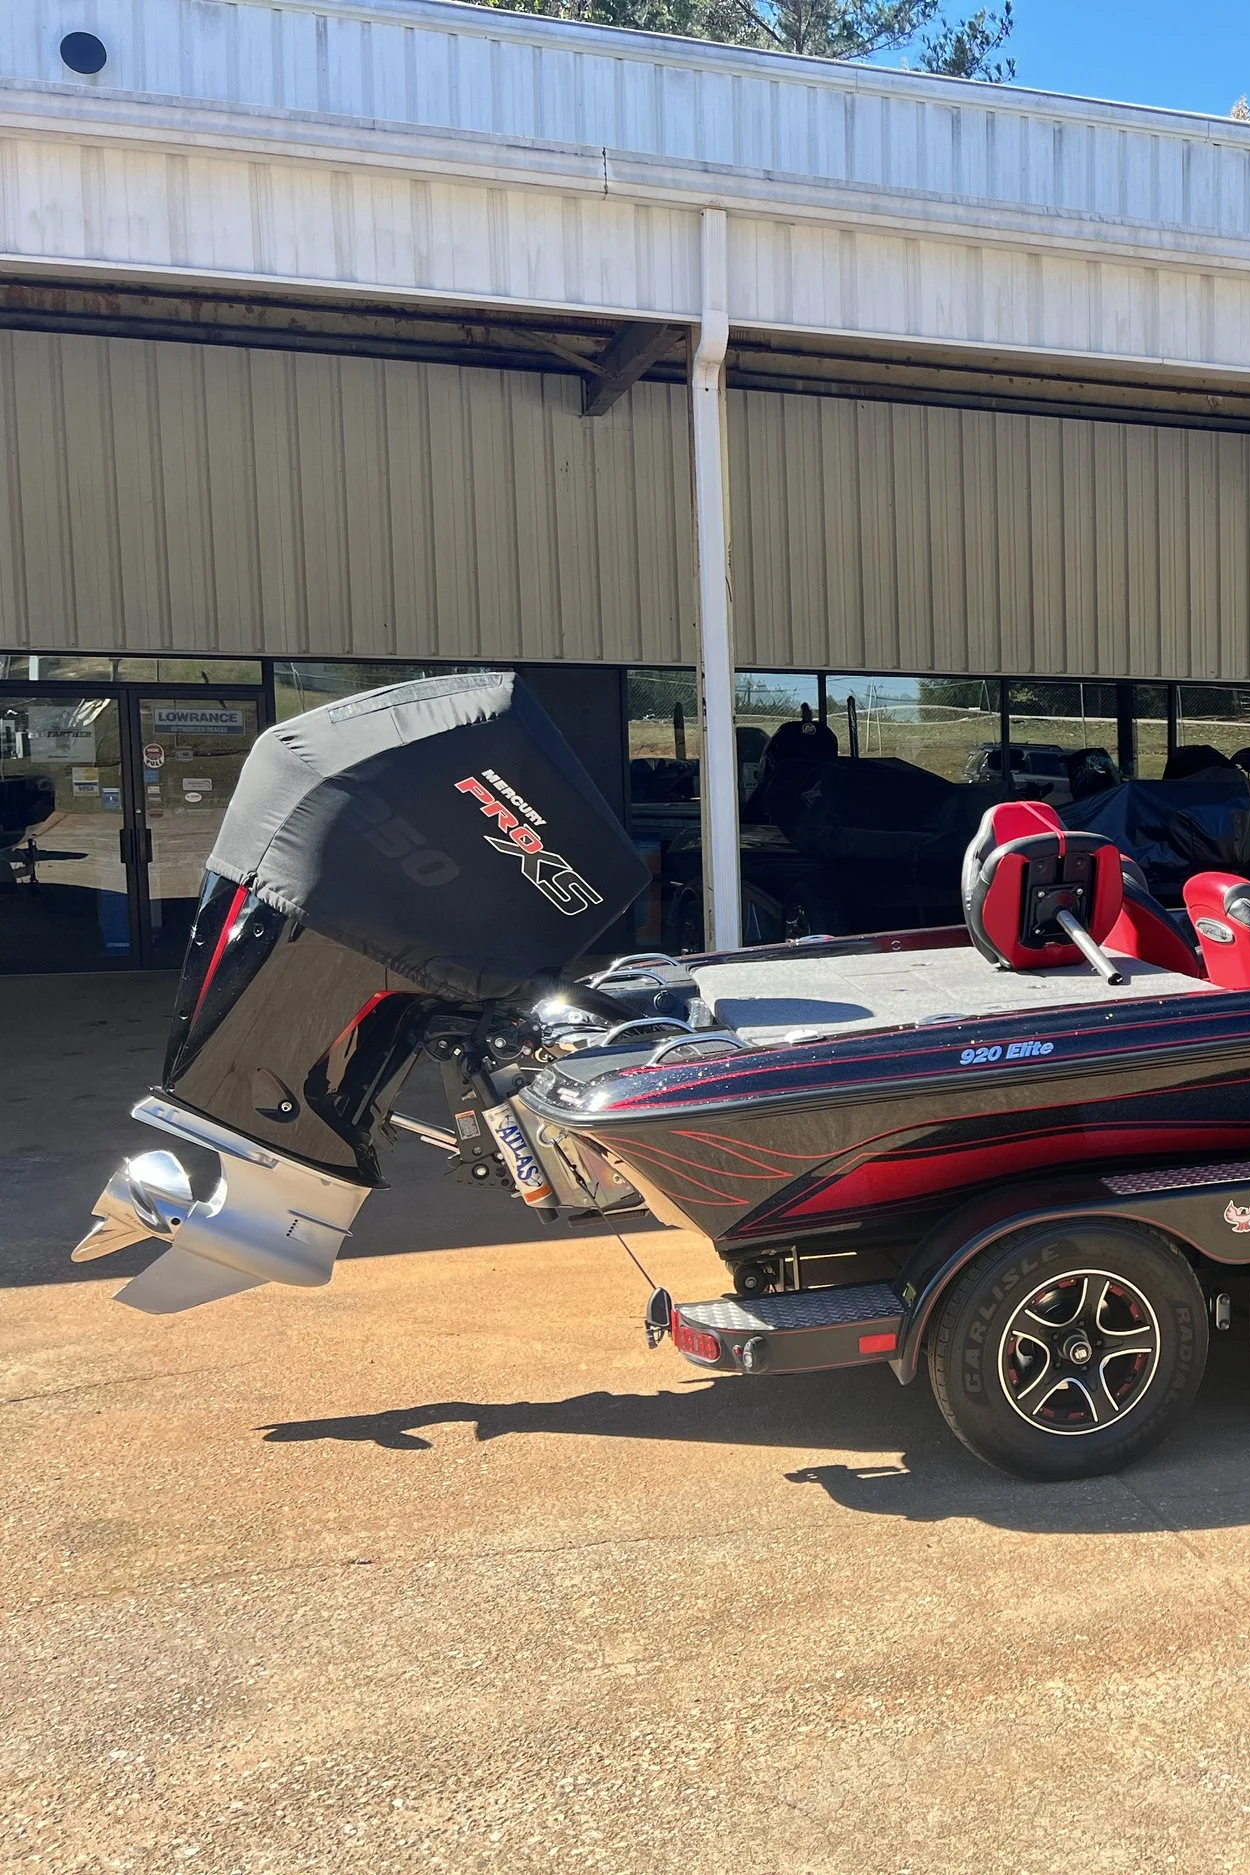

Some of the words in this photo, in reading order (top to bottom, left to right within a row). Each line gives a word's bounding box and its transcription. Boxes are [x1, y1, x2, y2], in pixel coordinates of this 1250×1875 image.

[158, 711, 238, 723] LOWRANCE
[481, 768, 547, 827] MERCURY
[959, 1045, 1003, 1065] 920
[1005, 1041, 1054, 1060] Elite
[495, 1125, 540, 1181] ATLAS
[965, 1242, 1061, 1393] CARLISLE
